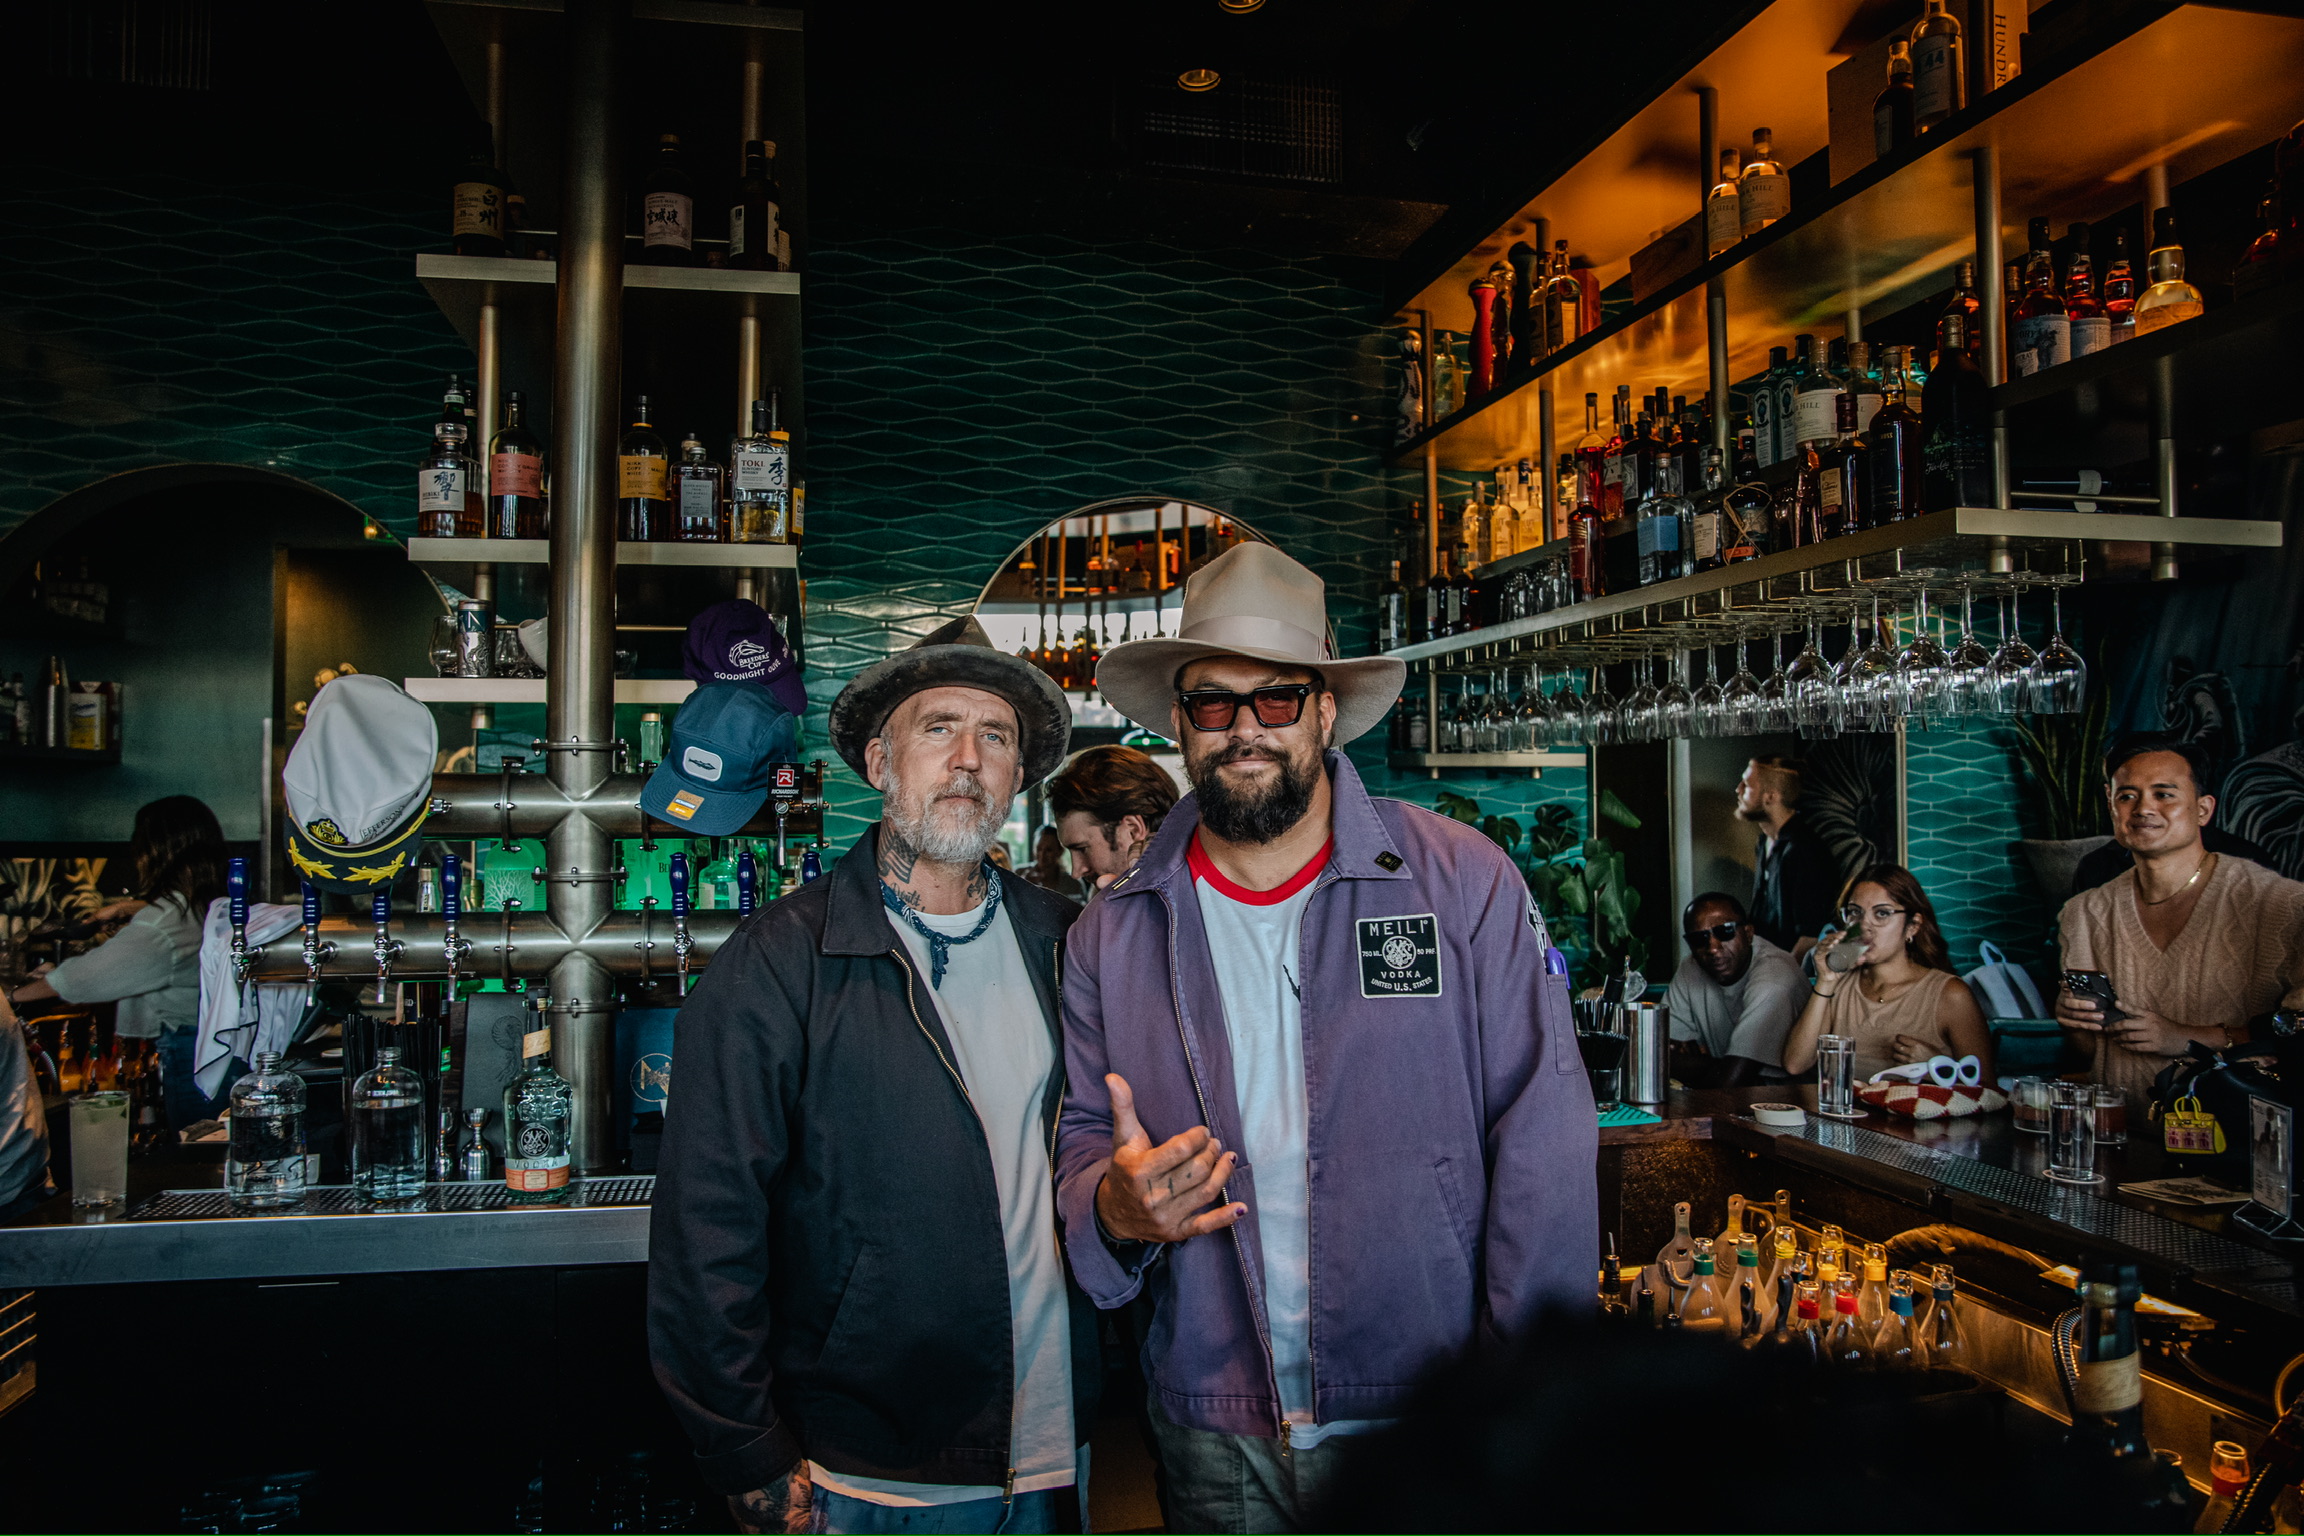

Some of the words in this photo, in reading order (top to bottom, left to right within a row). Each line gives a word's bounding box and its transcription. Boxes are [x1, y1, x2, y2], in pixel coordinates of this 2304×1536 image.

[741, 459, 765, 468] TOKI
[713, 668, 766, 680] GOODNIGHT
[767, 658, 782, 673] OLIVE
[747, 661, 763, 670] CUP
[1380, 970, 1421, 979] VODKA
[1370, 977, 1393, 990] UNITED
[1393, 982, 1413, 991] U.S.
[1412, 976, 1434, 990] STATES
[514, 1159, 558, 1169] VODKA
